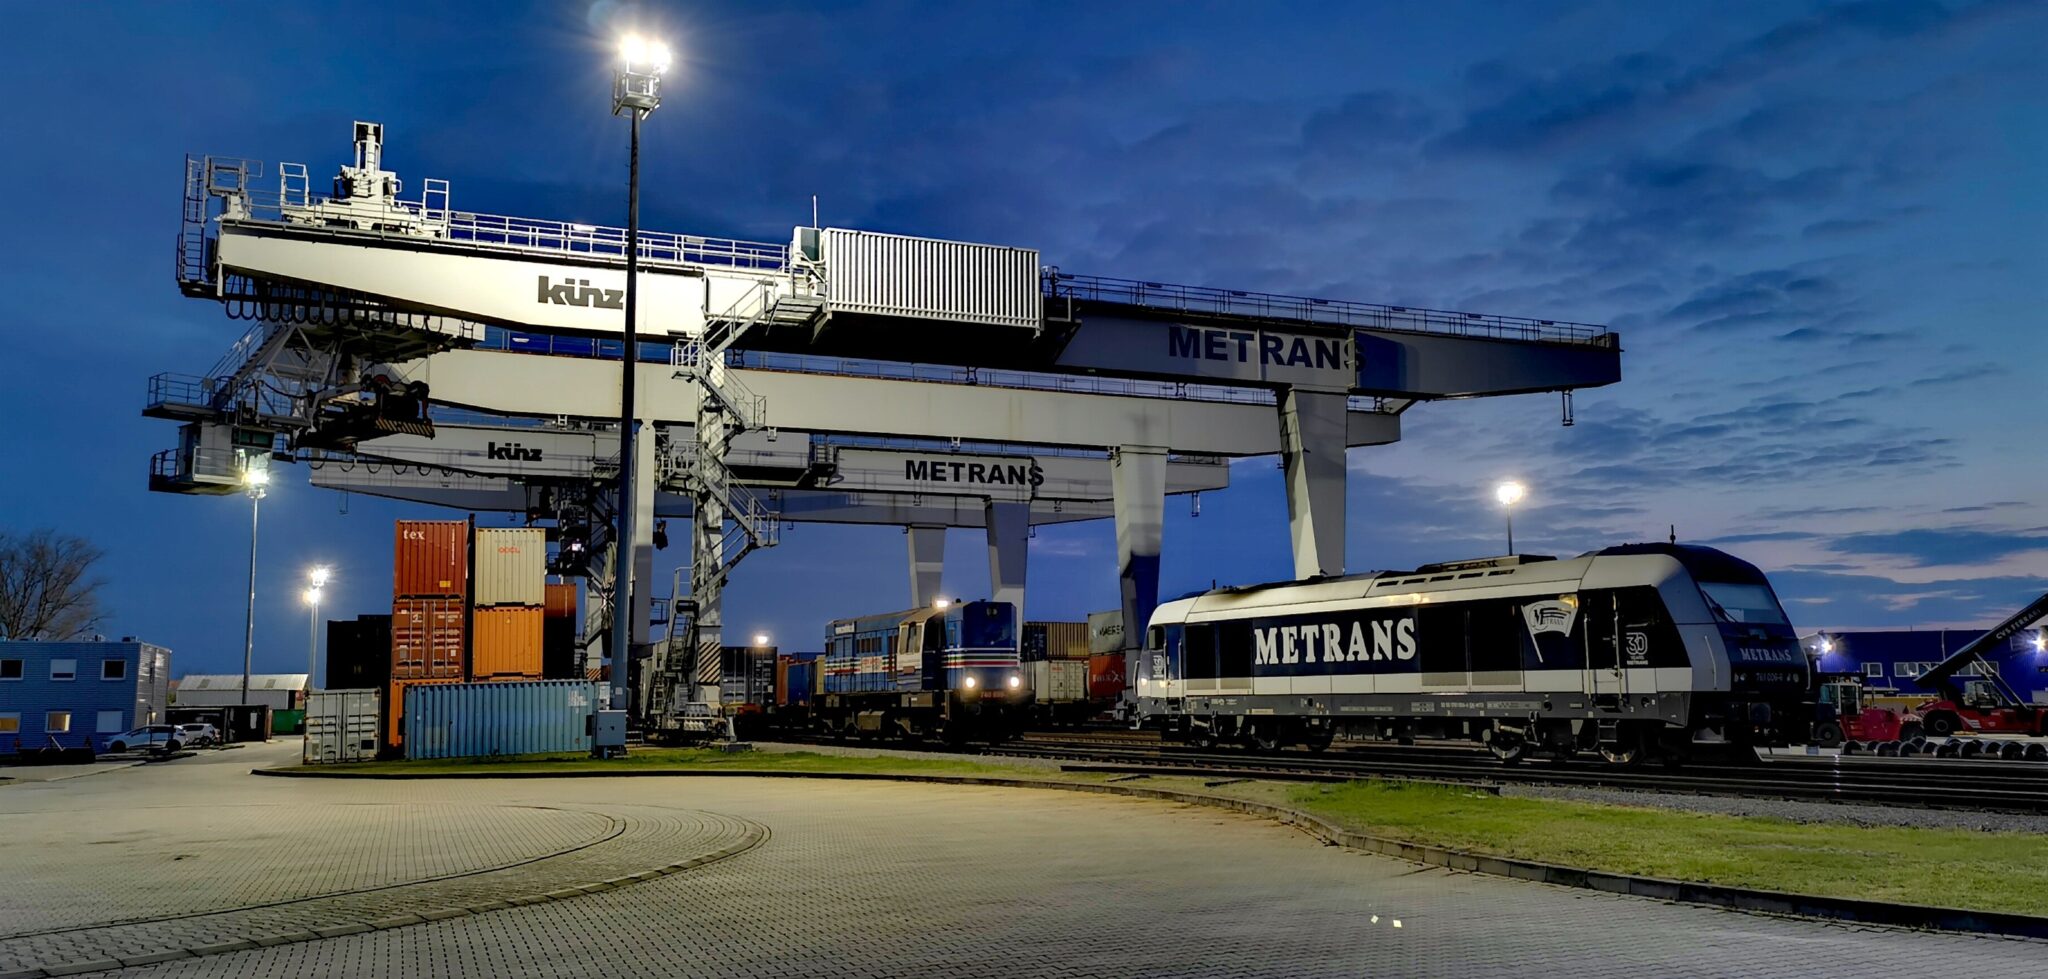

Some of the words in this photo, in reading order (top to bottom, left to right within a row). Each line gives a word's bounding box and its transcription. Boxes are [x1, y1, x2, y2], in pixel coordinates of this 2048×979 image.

[538, 275, 624, 311] künz
[1168, 326, 1367, 372] METRANS
[488, 442, 543, 462] künz
[905, 460, 1045, 486] METRANS
[403, 529, 425, 540] tex
[1254, 618, 1417, 665] METRANS
[1626, 632, 1648, 655] 30
[1739, 647, 1792, 661] METRANS
